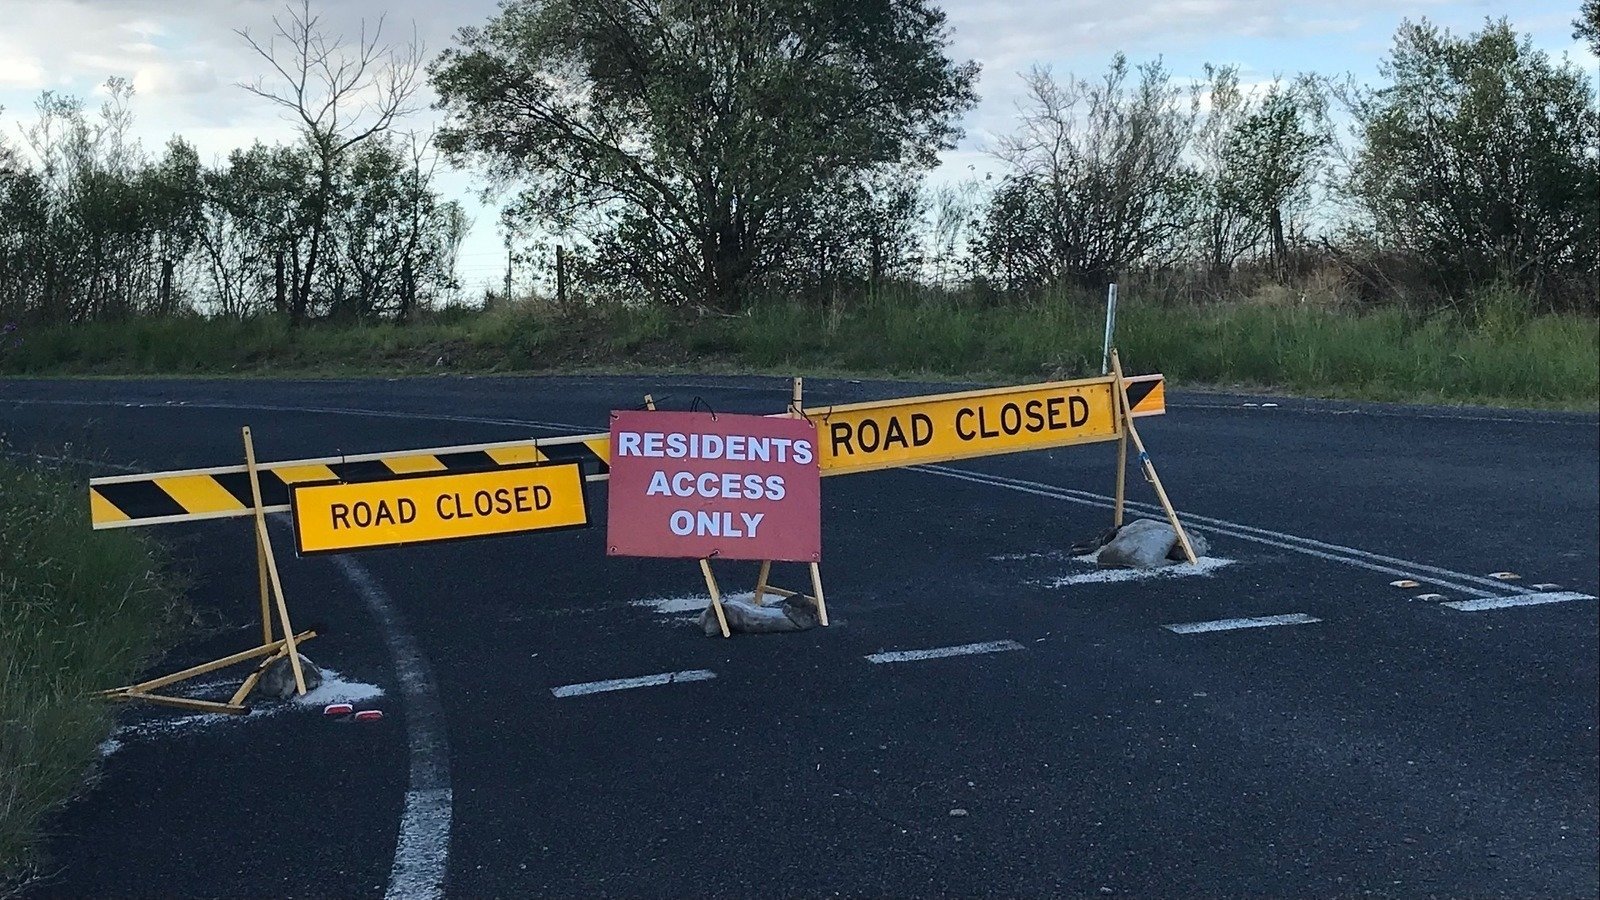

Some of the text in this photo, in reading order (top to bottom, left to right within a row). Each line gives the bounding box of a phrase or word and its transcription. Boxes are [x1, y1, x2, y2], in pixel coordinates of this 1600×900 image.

[831, 395, 1090, 457] ROAD CLOSED
[618, 432, 813, 465] RESIDENTS
[646, 471, 786, 501] ACCESS
[332, 485, 552, 530] ROAD CLOSED
[669, 510, 765, 539] ONLY
